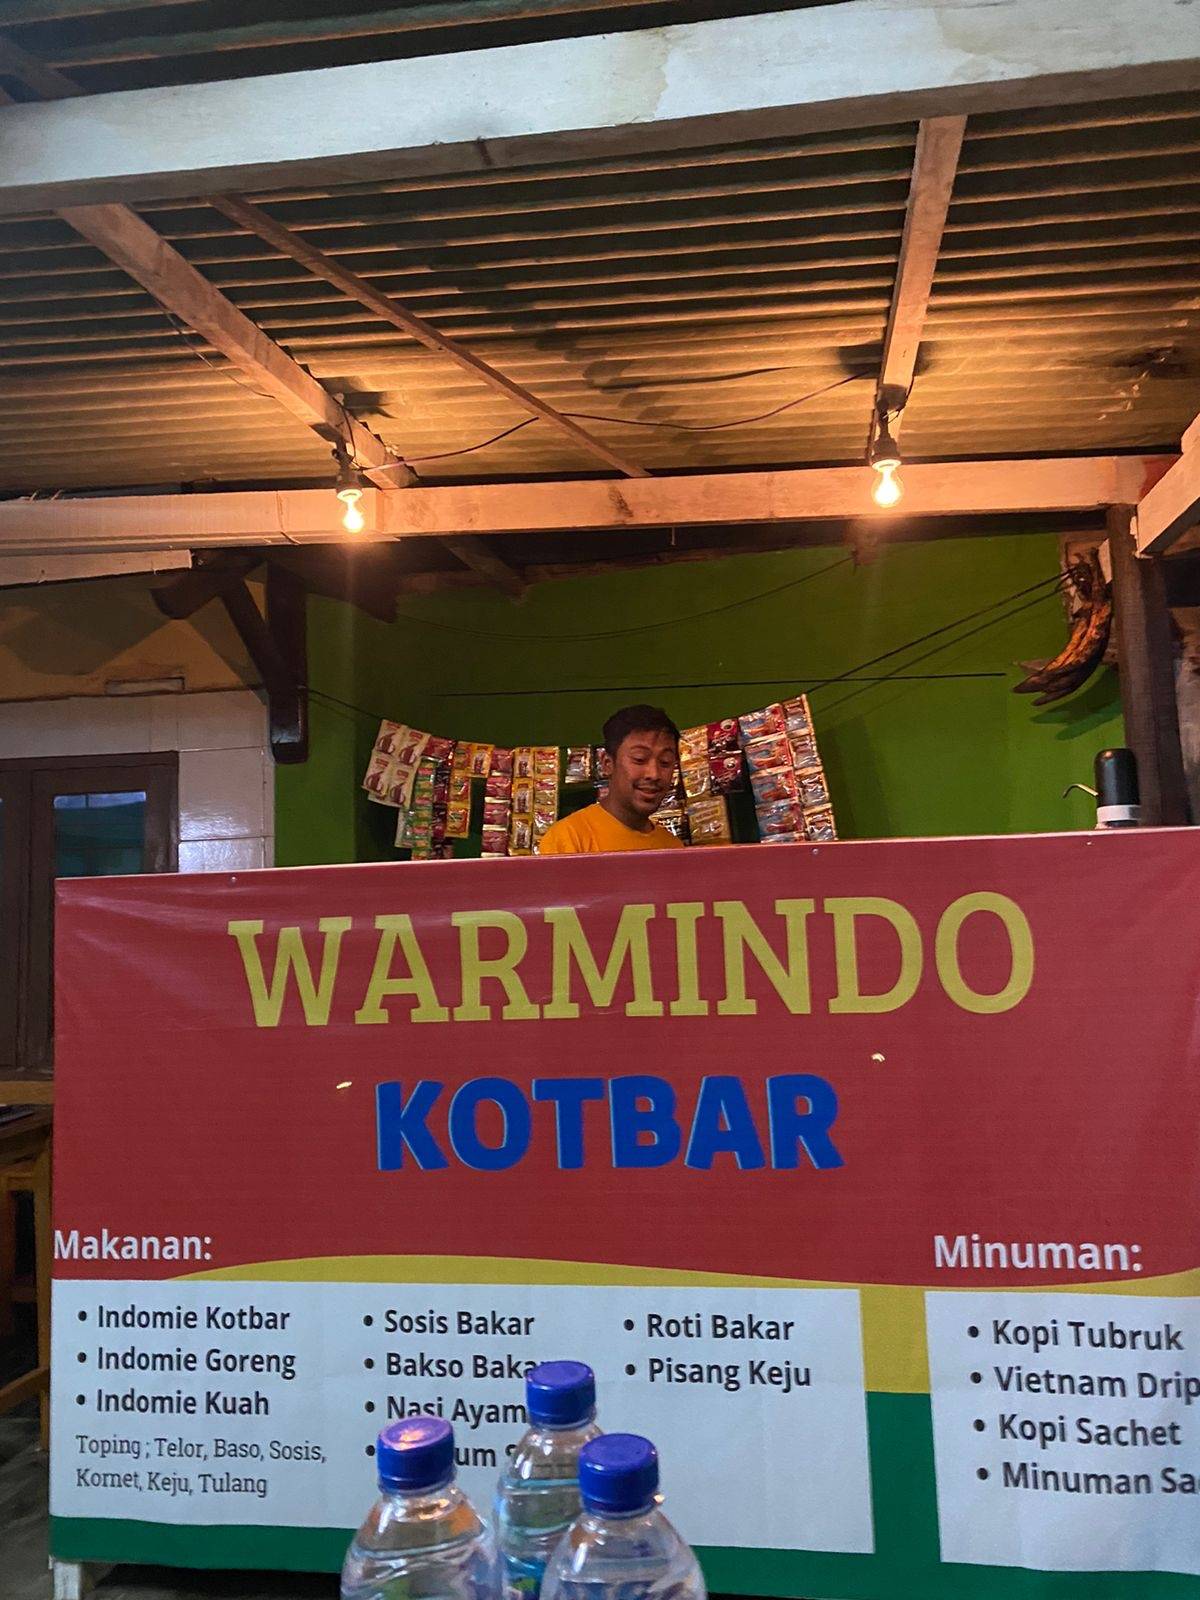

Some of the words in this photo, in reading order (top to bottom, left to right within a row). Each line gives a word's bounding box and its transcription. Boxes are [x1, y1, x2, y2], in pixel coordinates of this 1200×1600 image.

[227, 890, 1036, 1028] WARMINDO
[374, 1073, 846, 1171] KOTBAR
[53, 1228, 213, 1261] Makanan:
[933, 1233, 1143, 1272] Minuman:
[98, 1304, 198, 1330] Indomie
[205, 1306, 291, 1331] Kotbar
[384, 1309, 449, 1335] Sosis
[457, 1310, 535, 1336] Bakar
[647, 1313, 702, 1338] Roti
[711, 1313, 795, 1341] Bakar
[992, 1318, 1059, 1353] Kopi
[1067, 1321, 1184, 1351] Tubruk
[98, 1346, 198, 1372] Indomie
[205, 1348, 297, 1380] Goreng
[386, 1352, 464, 1378] Bakso
[472, 1354, 546, 1379] Baka
[649, 1357, 741, 1392] Pisang
[749, 1360, 811, 1394] Keju
[96, 1388, 197, 1414] Indomie
[205, 1391, 270, 1416] Kuah
[993, 1365, 1127, 1398] Vietnam
[1137, 1371, 1200, 1405] Drip
[387, 1396, 444, 1419] Nasi
[451, 1398, 527, 1430] Ayam
[999, 1413, 1067, 1450] Kopi
[1075, 1418, 1183, 1447] Sachet
[154, 1438, 209, 1461] Telor,
[213, 1439, 265, 1461] Baso,
[269, 1440, 327, 1463] Sosis,
[147, 1472, 193, 1496] Keju,
[198, 1473, 268, 1498] Tulang
[1003, 1461, 1152, 1495] Minuman
[1160, 1466, 1200, 1494] Sa
